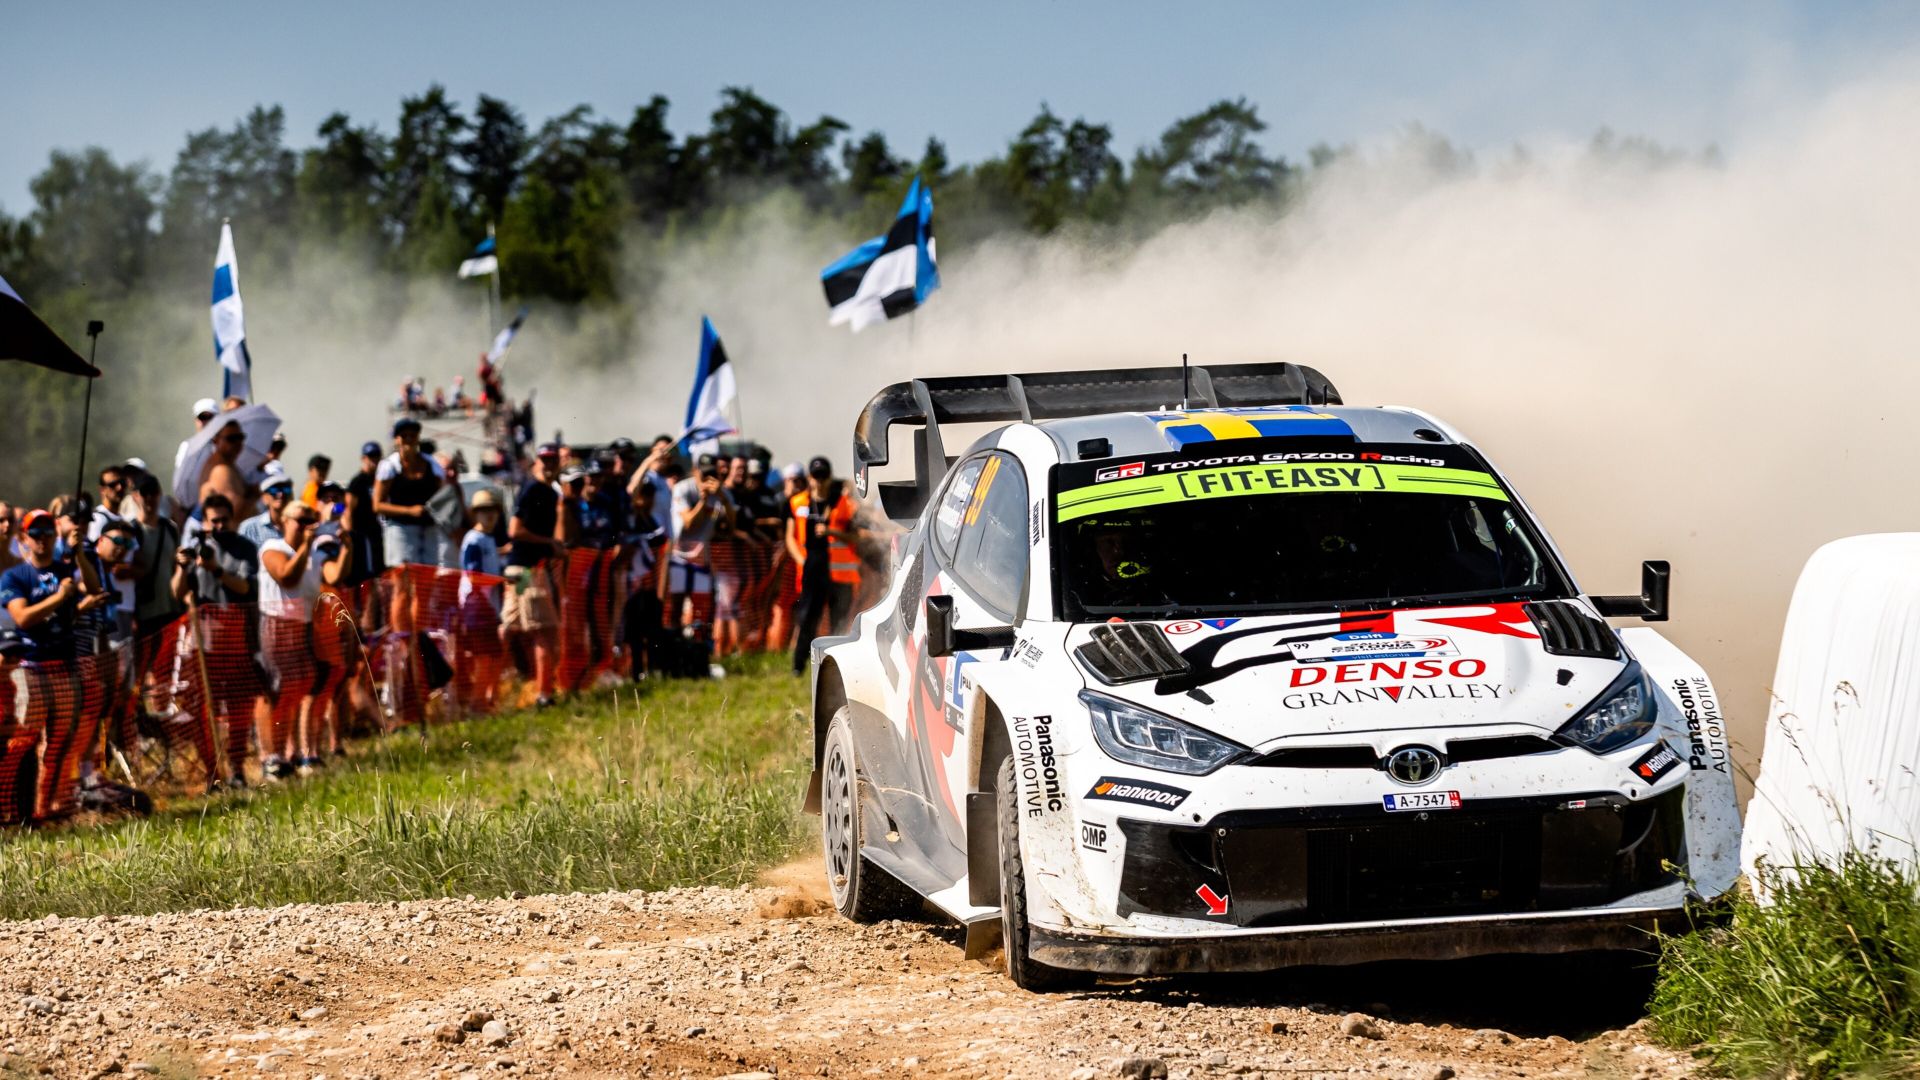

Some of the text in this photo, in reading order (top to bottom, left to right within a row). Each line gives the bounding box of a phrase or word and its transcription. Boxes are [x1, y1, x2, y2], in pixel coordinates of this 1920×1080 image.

[1098, 453, 1445, 482] GR TOYOTA GAZOO Racing
[1293, 642, 1310, 650] 99
[1289, 659, 1487, 688] DENSO
[1282, 684, 1503, 709] GRANVALLEY
[1672, 678, 1707, 771] Panasonic
[1691, 677, 1727, 774] AUTOMOTIVE
[1012, 716, 1043, 818] AUTOMOTIVE
[1033, 714, 1062, 813] Panasonic
[1400, 794, 1445, 807] A-7547
[1082, 825, 1107, 847] OMP
